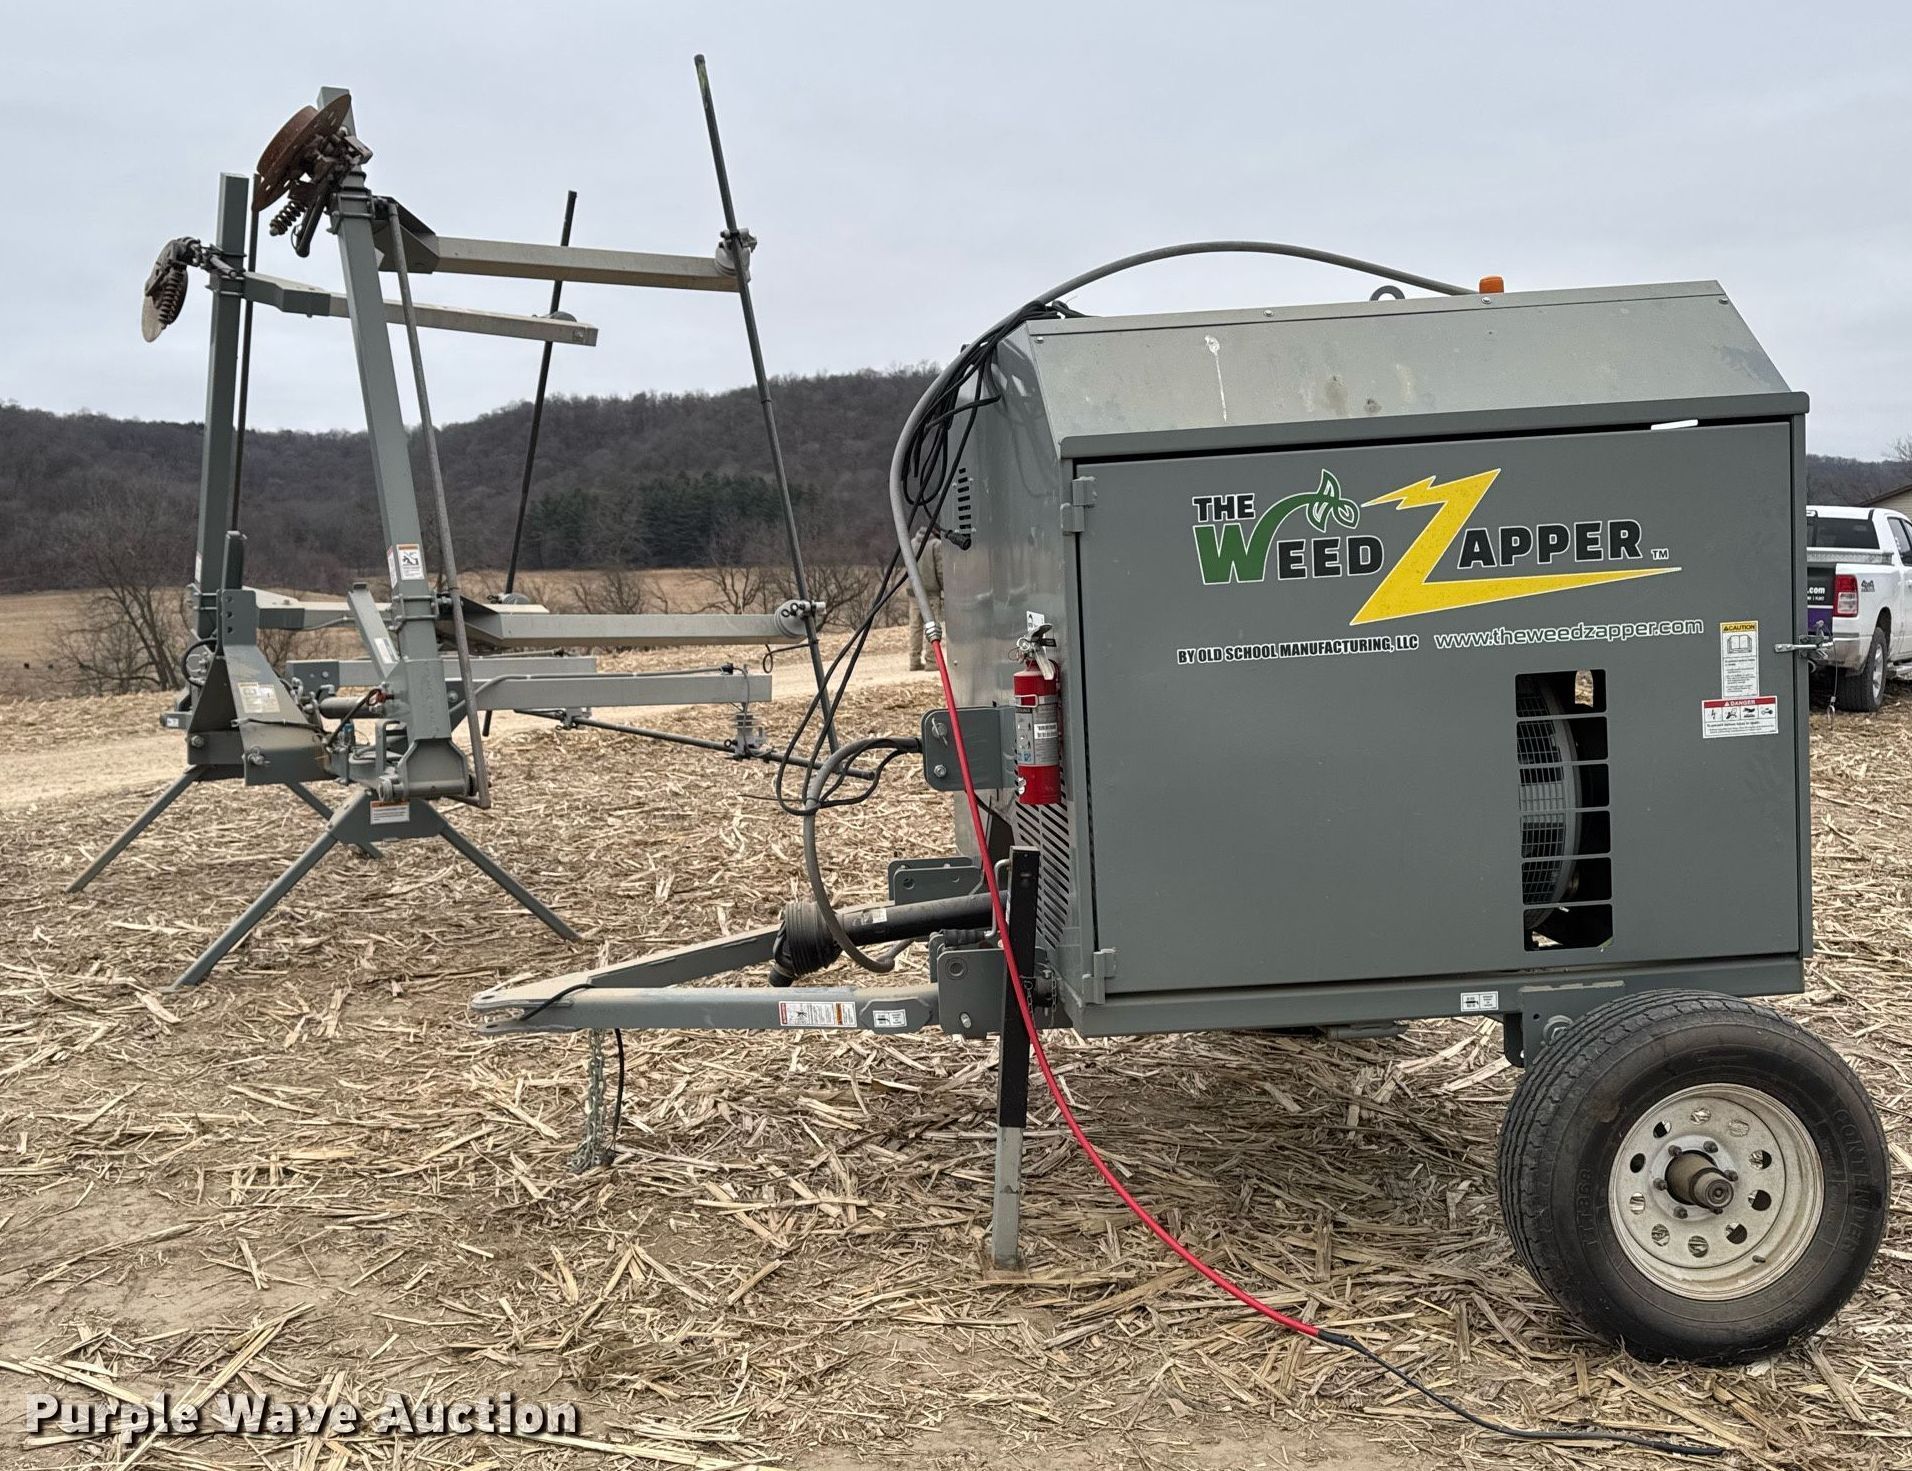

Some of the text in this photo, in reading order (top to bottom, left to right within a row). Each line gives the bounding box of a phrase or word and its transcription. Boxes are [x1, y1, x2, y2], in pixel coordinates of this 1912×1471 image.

[1192, 493, 1255, 522] THE
[1193, 493, 1385, 585] WEED
[1651, 548, 1669, 560] TM
[1434, 619, 1704, 649] www.theweedzapper.com
[1178, 635, 1419, 664] BY OLD SCHOOL MANUFACTURING, LLC
